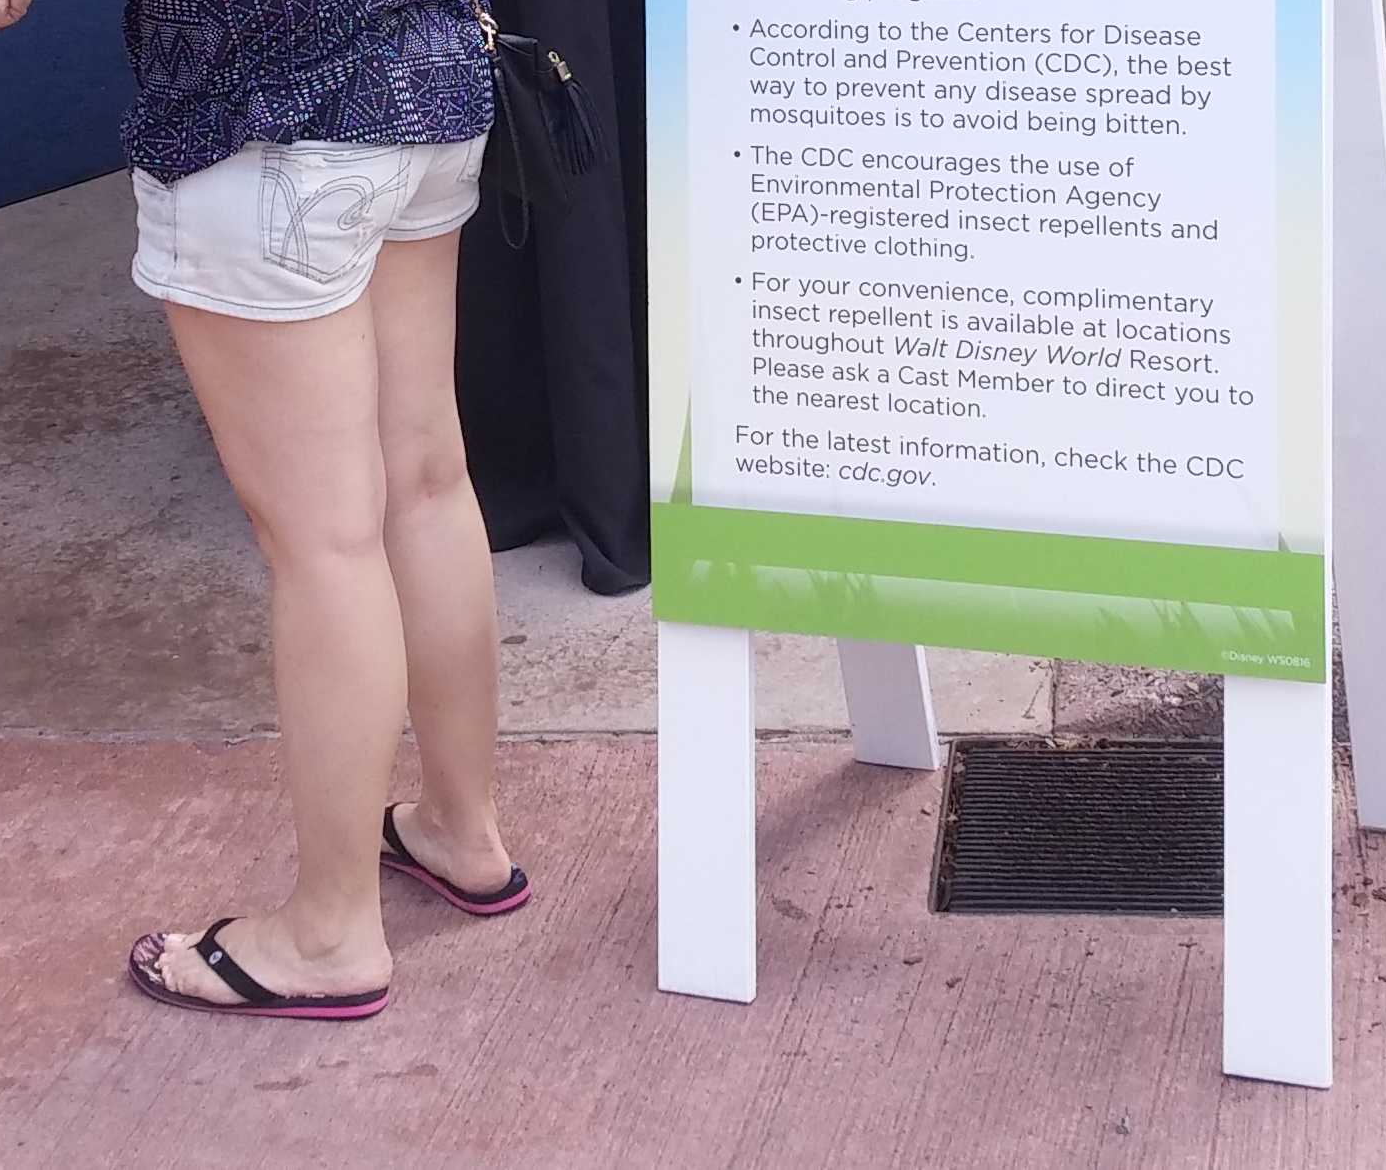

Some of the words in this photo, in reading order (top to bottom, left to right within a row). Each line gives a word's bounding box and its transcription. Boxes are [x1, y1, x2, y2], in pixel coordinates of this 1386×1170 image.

[749, 18, 869, 44] According
[877, 21, 902, 41] to
[910, 20, 949, 42] the
[957, 21, 1051, 44] Centers
[1060, 22, 1096, 45] for
[1104, 24, 1201, 47] Disease
[749, 46, 835, 68] Control
[843, 48, 887, 69] and
[896, 49, 1026, 72] Prevention
[1034, 52, 1118, 78] (CDC),
[1126, 53, 1168, 76] the
[1177, 54, 1232, 77] best
[749, 79, 796, 100] way
[803, 77, 828, 97] to
[836, 79, 926, 101] prevent
[934, 84, 977, 104] any
[985, 80, 1077, 103] disease
[1085, 84, 1171, 108] spread
[1181, 84, 1212, 111] by
[750, 104, 886, 129] mosquitoes
[895, 106, 912, 128] is
[919, 108, 945, 129] to
[952, 109, 1018, 131] avoid
[1027, 109, 1096, 137] being
[1106, 112, 1187, 136] bitten.
[750, 144, 793, 166] The
[801, 147, 854, 168] CDC
[861, 153, 1001, 176] encourages
[1009, 153, 1049, 175] the
[1058, 160, 1100, 177] use
[1108, 156, 1135, 178] of
[751, 173, 920, 199] Environmental
[930, 179, 1056, 205] Protection
[1065, 185, 1162, 213] Agency
[751, 201, 949, 230] (EPA)-registered
[958, 209, 1031, 233] insect
[1039, 214, 1162, 239] repellents
[1170, 219, 1218, 241] and
[751, 232, 867, 254] protective
[874, 235, 975, 263] clothing.
[752, 271, 791, 293] For
[798, 278, 851, 298] your
[858, 280, 1015, 307] convenience,
[1023, 287, 1214, 318] complimentary
[752, 299, 821, 323] insect
[828, 305, 933, 329] repellent
[941, 309, 959, 330] is
[967, 312, 1075, 337] available
[1082, 318, 1107, 339] at
[1116, 317, 1231, 345] locations
[752, 327, 885, 355] throughout
[894, 335, 949, 359] Walt
[955, 339, 1038, 367] Disney
[1047, 344, 1123, 368] World
[1130, 349, 1219, 374] Resort.
[753, 356, 825, 380] Please
[832, 361, 870, 383] ask
[877, 368, 890, 384] a
[898, 365, 950, 388] Cast
[958, 368, 1055, 394] Member
[1062, 375, 1087, 396] to
[1095, 376, 1166, 401] direct
[1174, 386, 1219, 406] you
[1228, 385, 1254, 406] to
[752, 384, 789, 406] the
[796, 391, 880, 412] nearest
[888, 392, 987, 419] location.
[736, 424, 775, 446] For
[781, 427, 819, 450] the
[827, 429, 891, 455] latest
[899, 435, 1046, 469] information,
[1054, 446, 1128, 472] check
[1136, 452, 1177, 475] the
[1186, 455, 1244, 480] CDC
[735, 454, 830, 479] website:
[838, 461, 936, 488] cdc.gov.
[1267, 653, 1311, 668] WS0816
